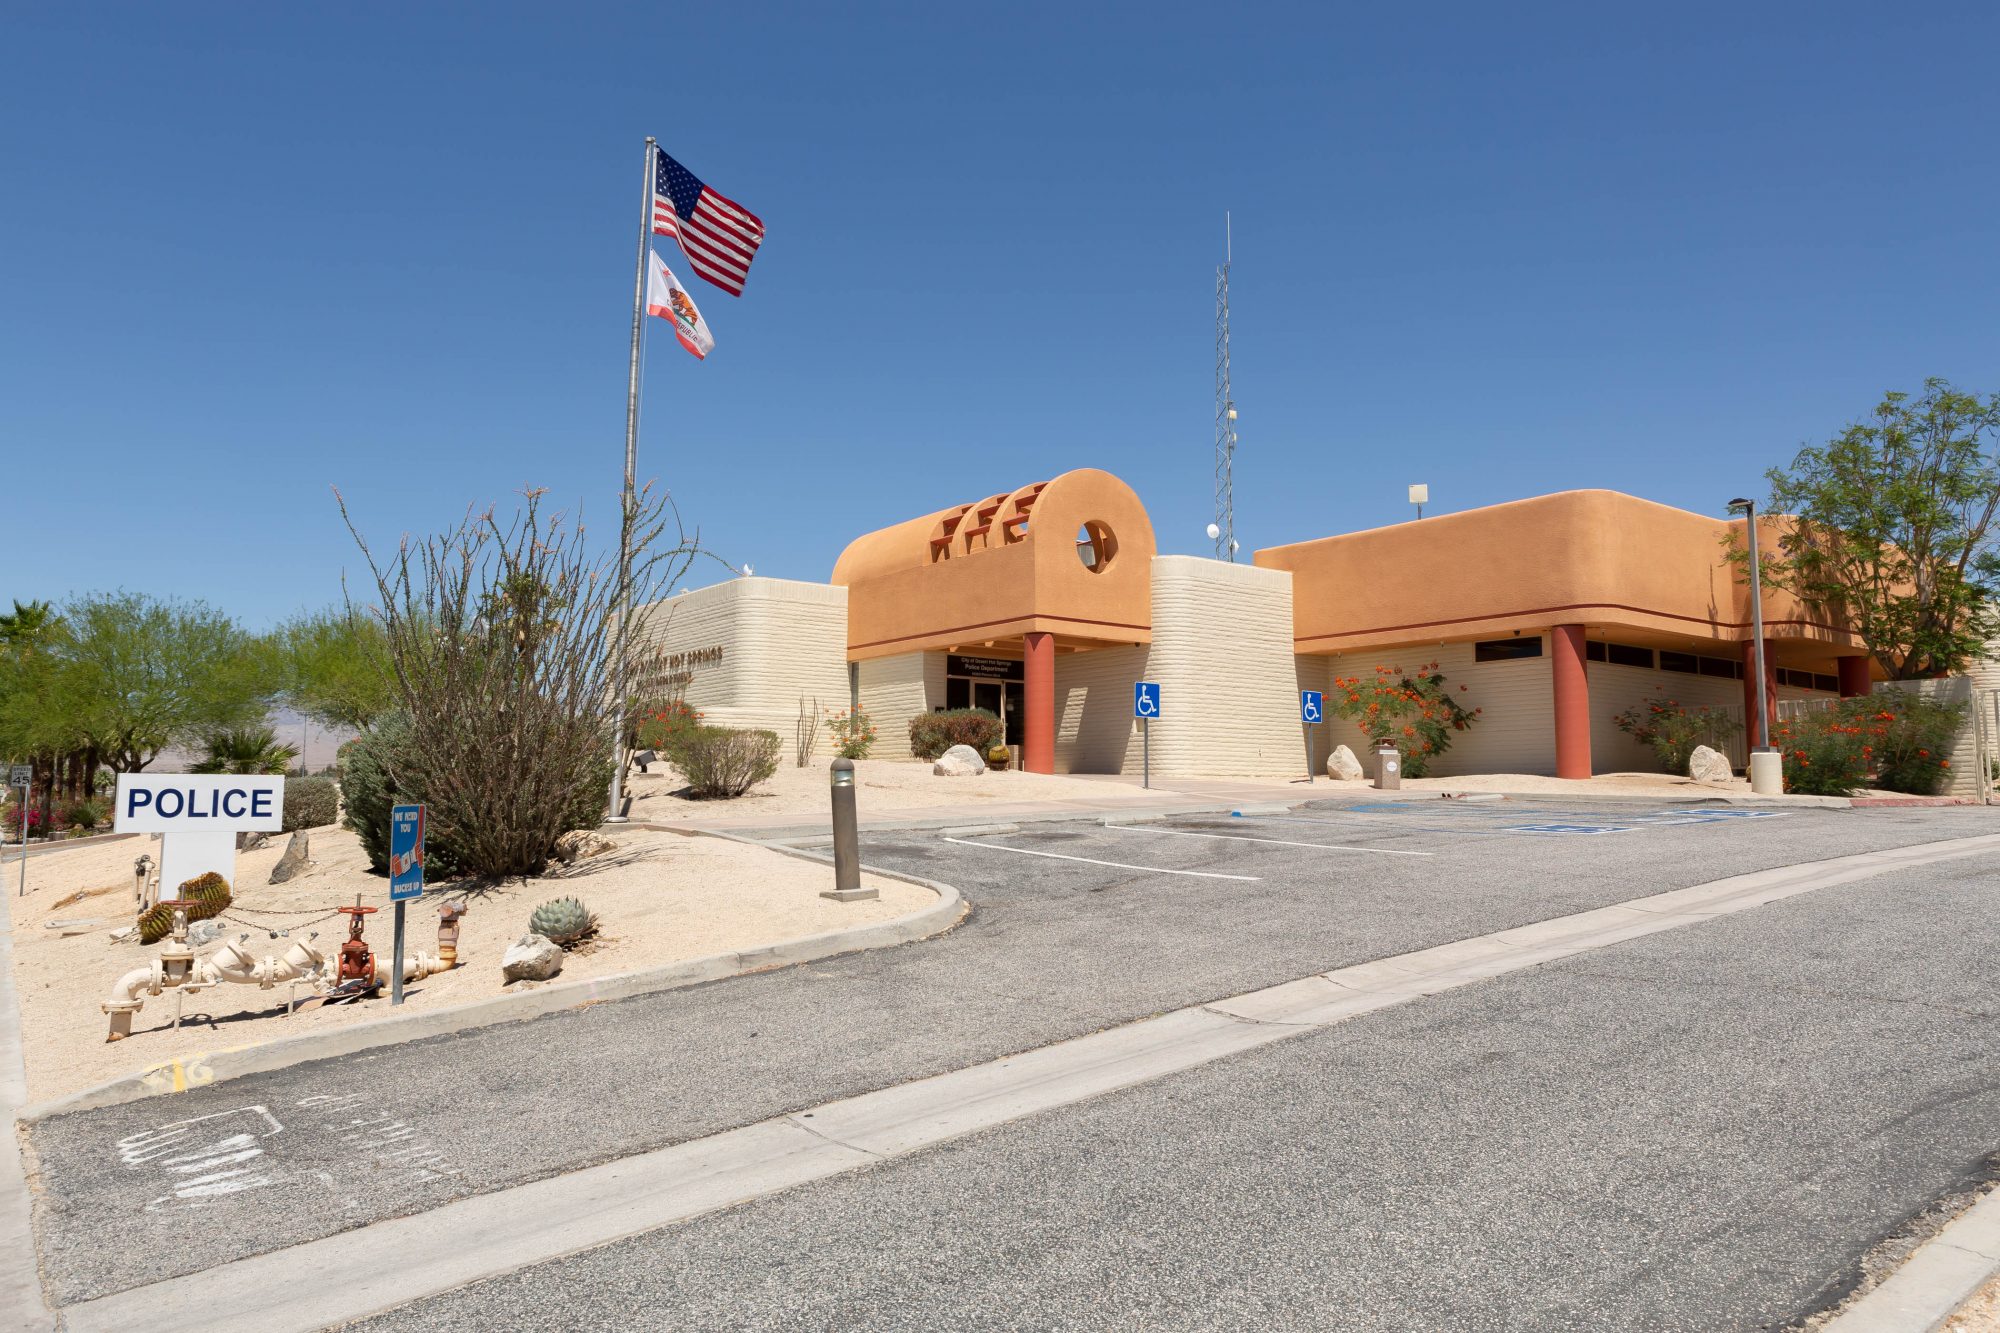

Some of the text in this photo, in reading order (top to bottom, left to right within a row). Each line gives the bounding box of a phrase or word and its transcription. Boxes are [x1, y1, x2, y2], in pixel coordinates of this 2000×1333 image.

[687, 645, 723, 666] SPRINGS
[980, 665, 1008, 673] Department
[12, 776, 31, 785] 45
[127, 788, 273, 819] POLICE
[394, 811, 418, 822] WE NEED
[400, 823, 411, 833] YOU
[394, 881, 420, 894] BUCKLE UP
